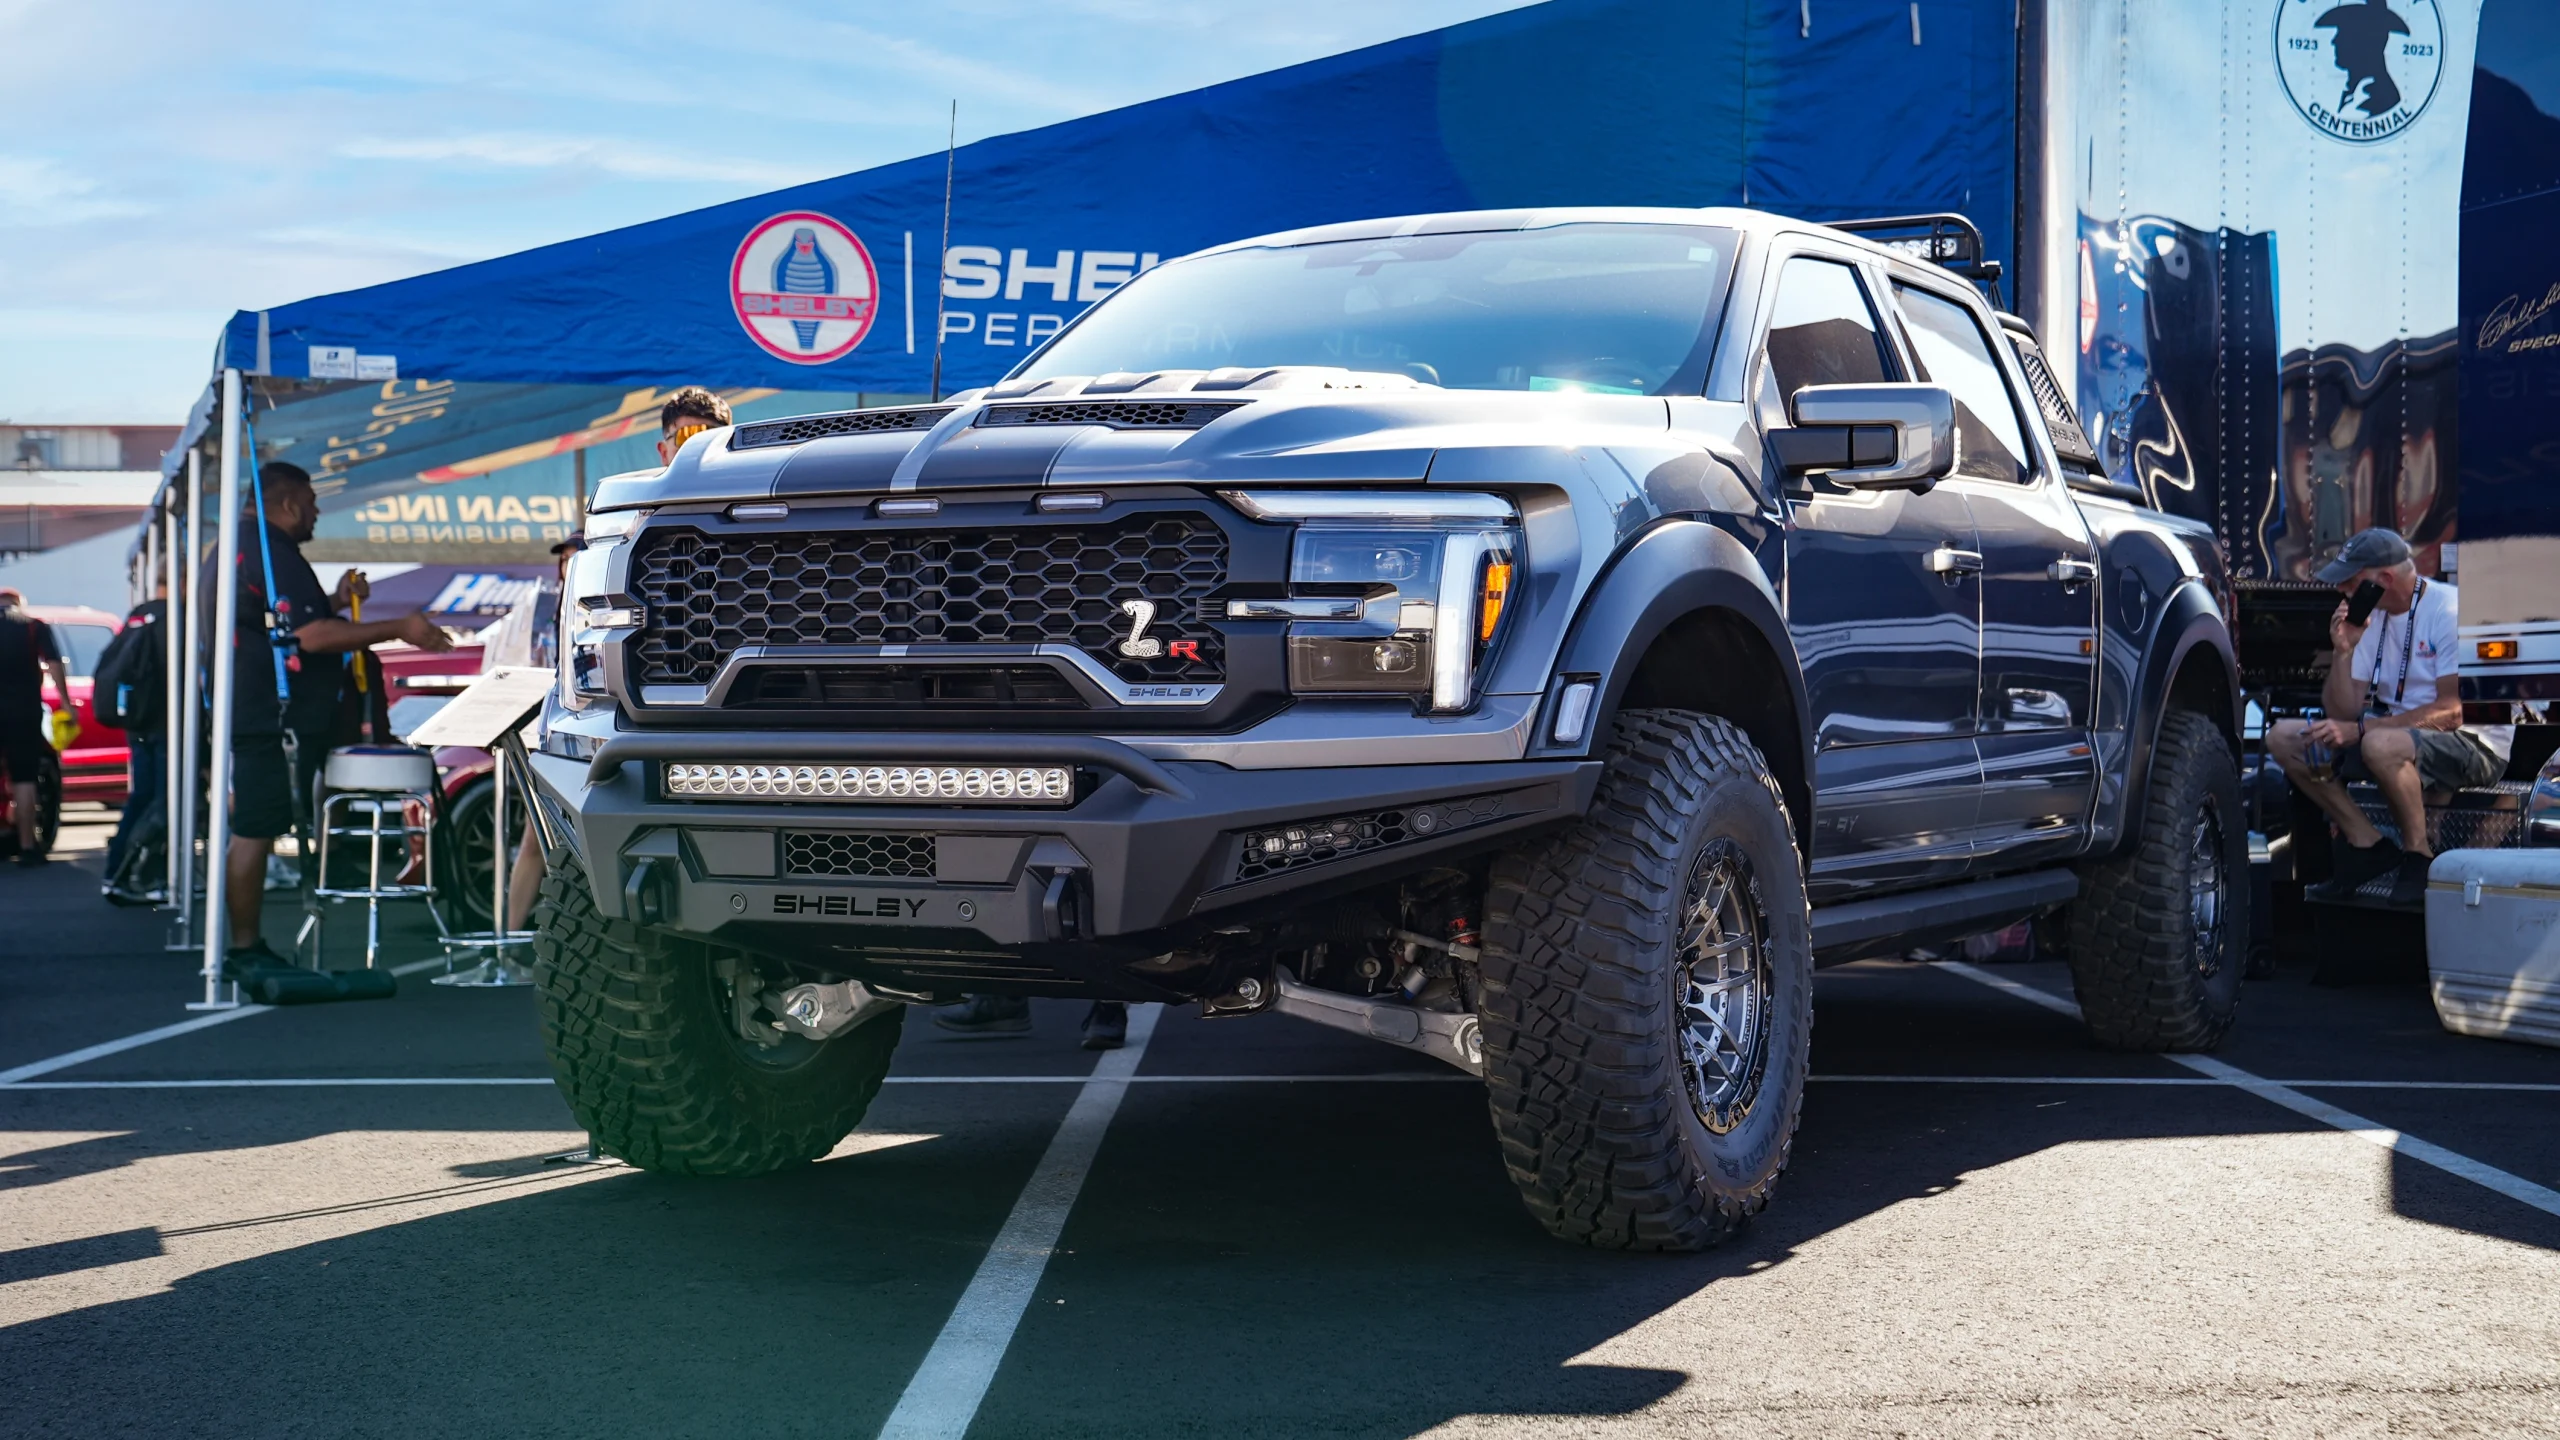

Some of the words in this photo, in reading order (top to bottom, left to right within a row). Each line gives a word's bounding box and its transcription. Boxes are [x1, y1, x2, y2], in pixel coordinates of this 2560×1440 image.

[2287, 37, 2318, 51] 1923
[2402, 44, 2434, 57] 2023
[2308, 102, 2412, 138] CENTENNIAL
[742, 295, 872, 318] SHELBY
[1169, 640, 1206, 663] R
[1128, 687, 1207, 698] SHELBY
[773, 894, 928, 918] SHELBY
